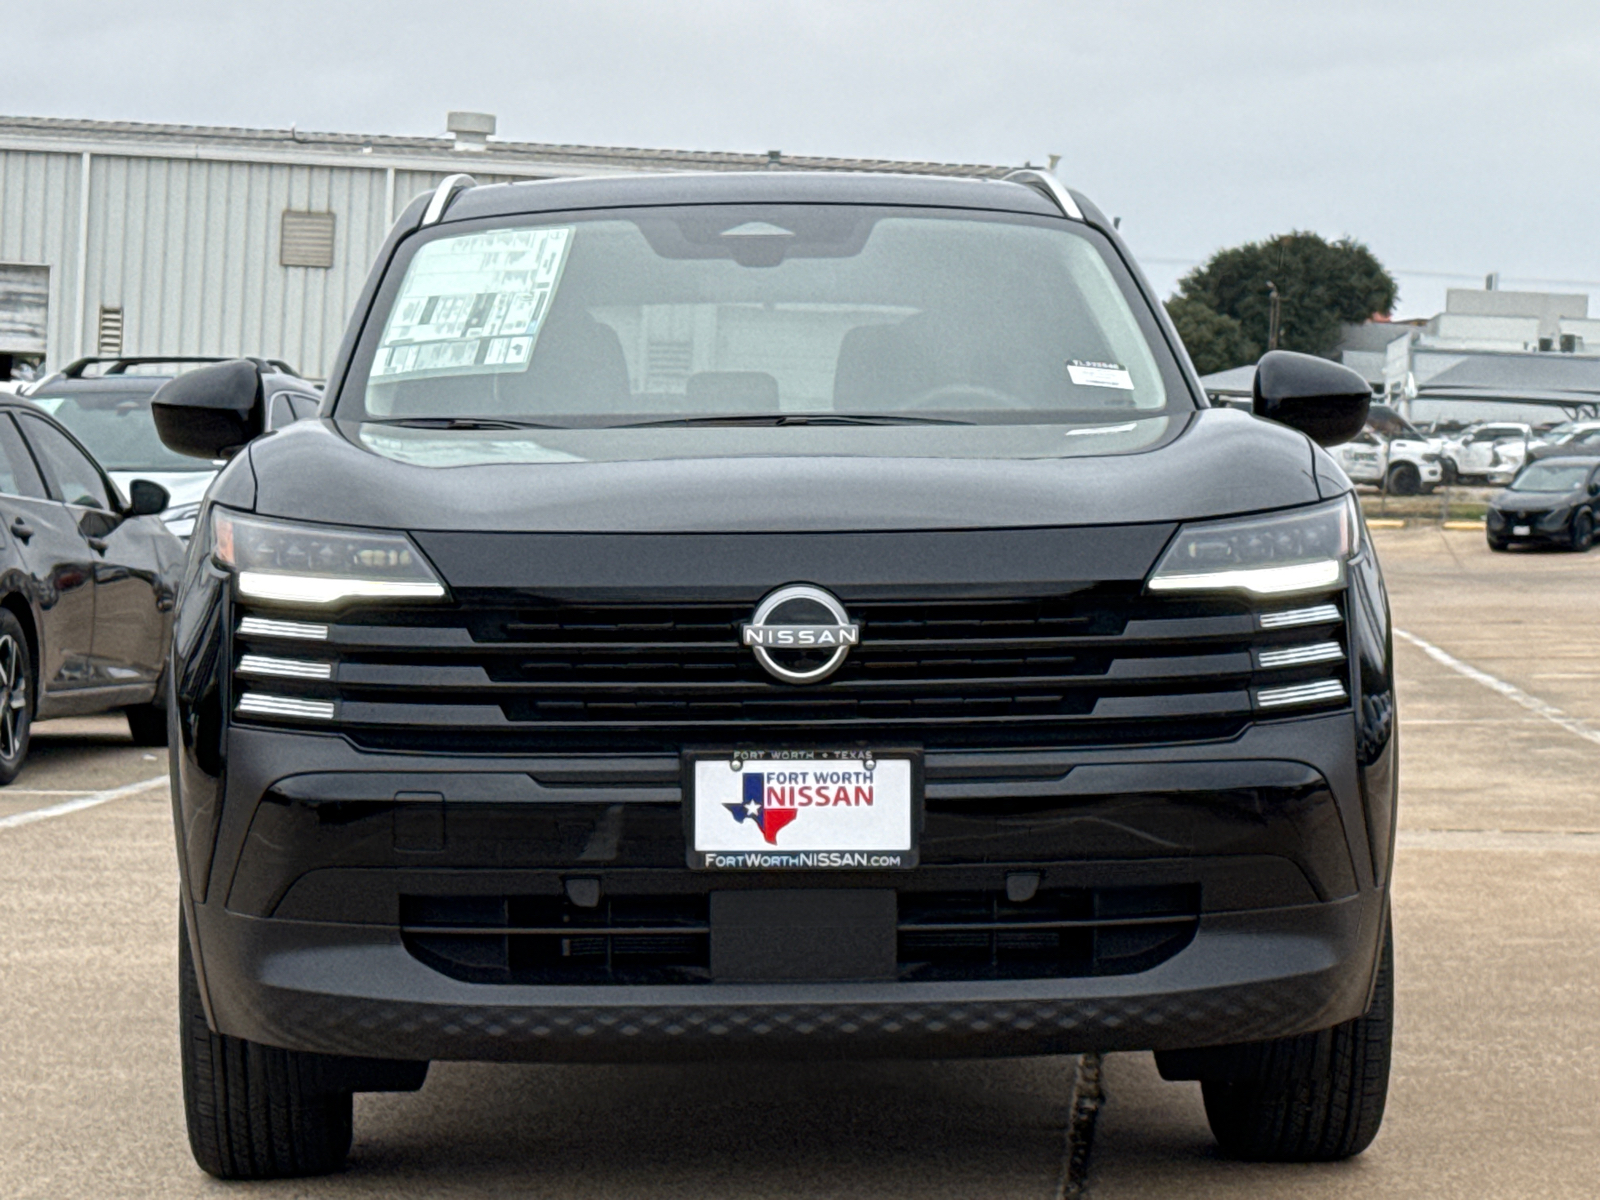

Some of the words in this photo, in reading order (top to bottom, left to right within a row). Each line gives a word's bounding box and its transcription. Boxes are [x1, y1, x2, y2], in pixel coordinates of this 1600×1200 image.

[745, 629, 856, 644] NISSAN
[733, 751, 765, 760] FORT
[771, 751, 815, 760] WORTH
[833, 751, 873, 760] TEXAS
[766, 772, 809, 785] FORT
[813, 771, 874, 784] WORTH
[766, 786, 874, 807] NISSAN
